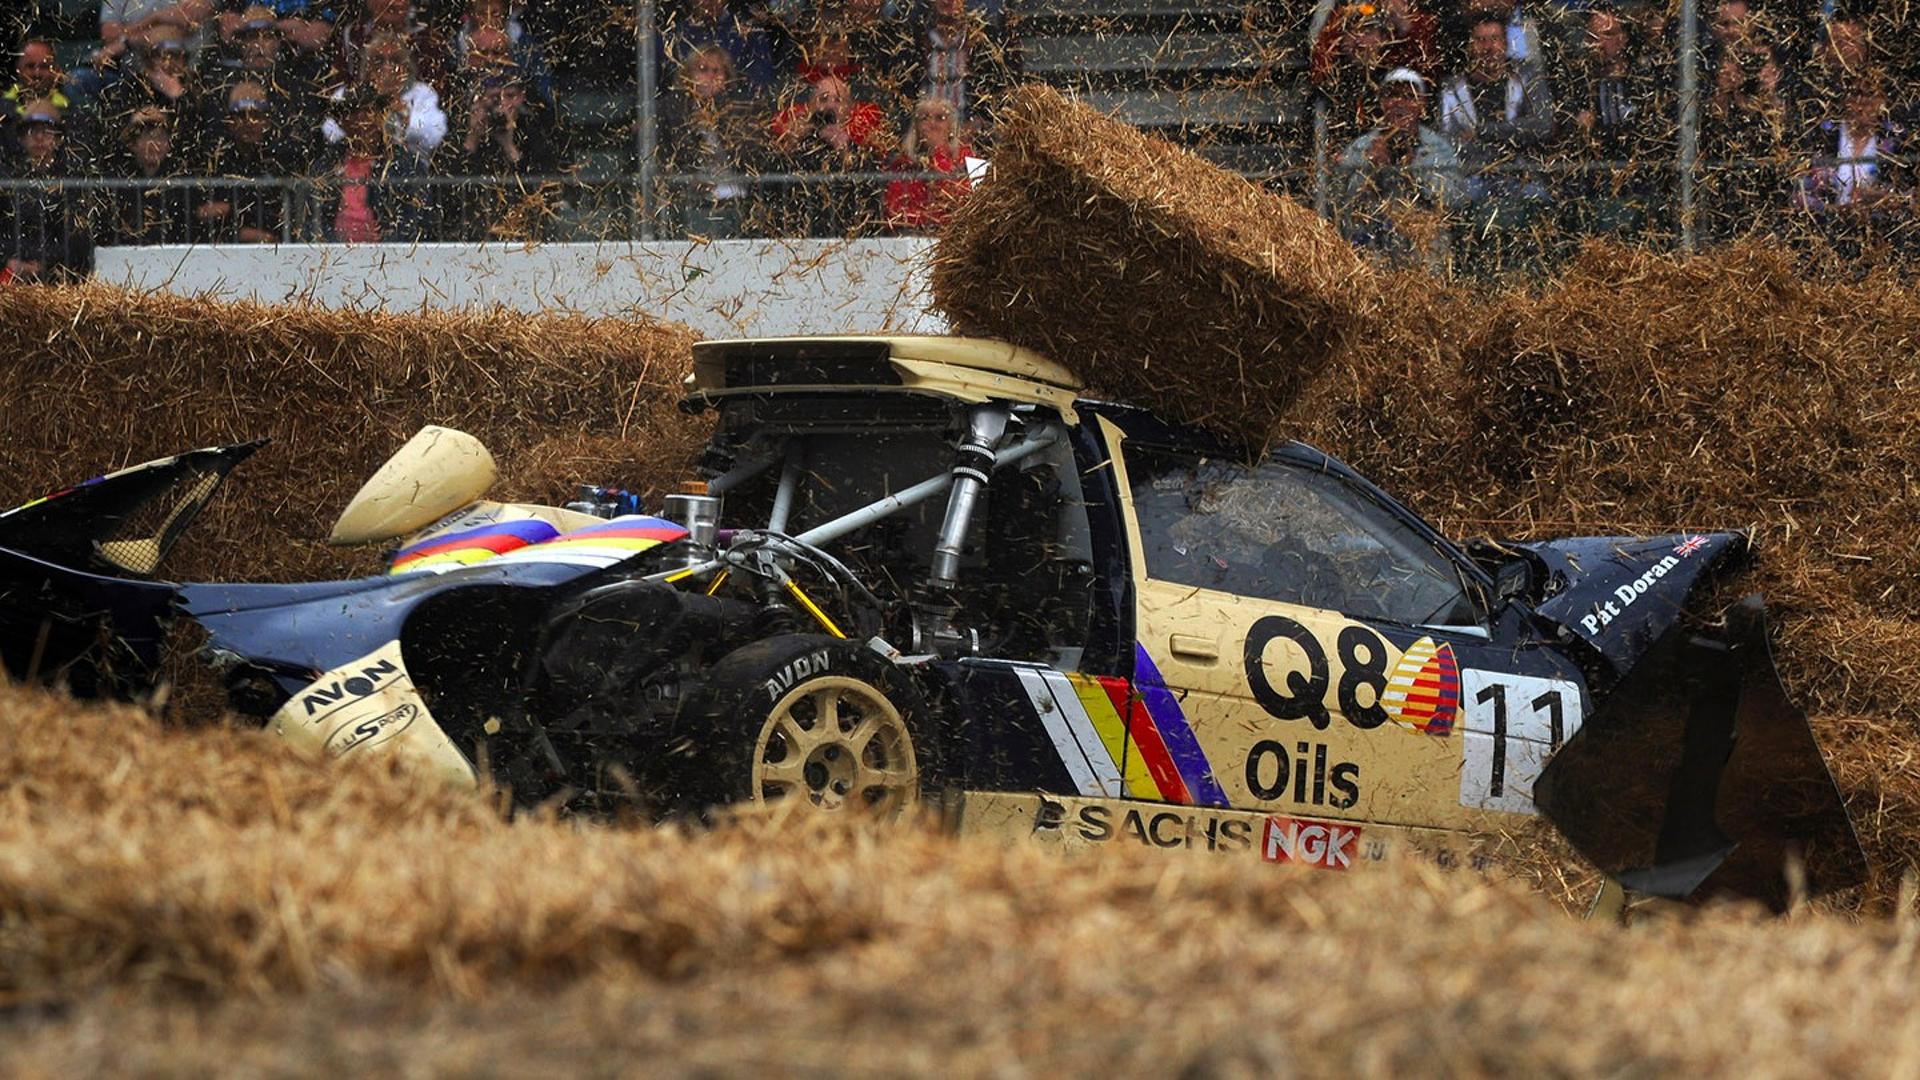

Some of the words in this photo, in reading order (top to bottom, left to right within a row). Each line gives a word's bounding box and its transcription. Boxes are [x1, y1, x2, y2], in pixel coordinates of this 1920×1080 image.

[1580, 601, 1620, 635] Pat
[1614, 555, 1679, 606] Doran
[302, 659, 397, 716] AVON
[766, 651, 829, 701] AVON
[1244, 615, 1390, 730] Q8
[1476, 684, 1564, 798] 11
[1245, 740, 1359, 808] Oils
[1079, 806, 1252, 851] SACHS
[1267, 820, 1355, 869] NGK
